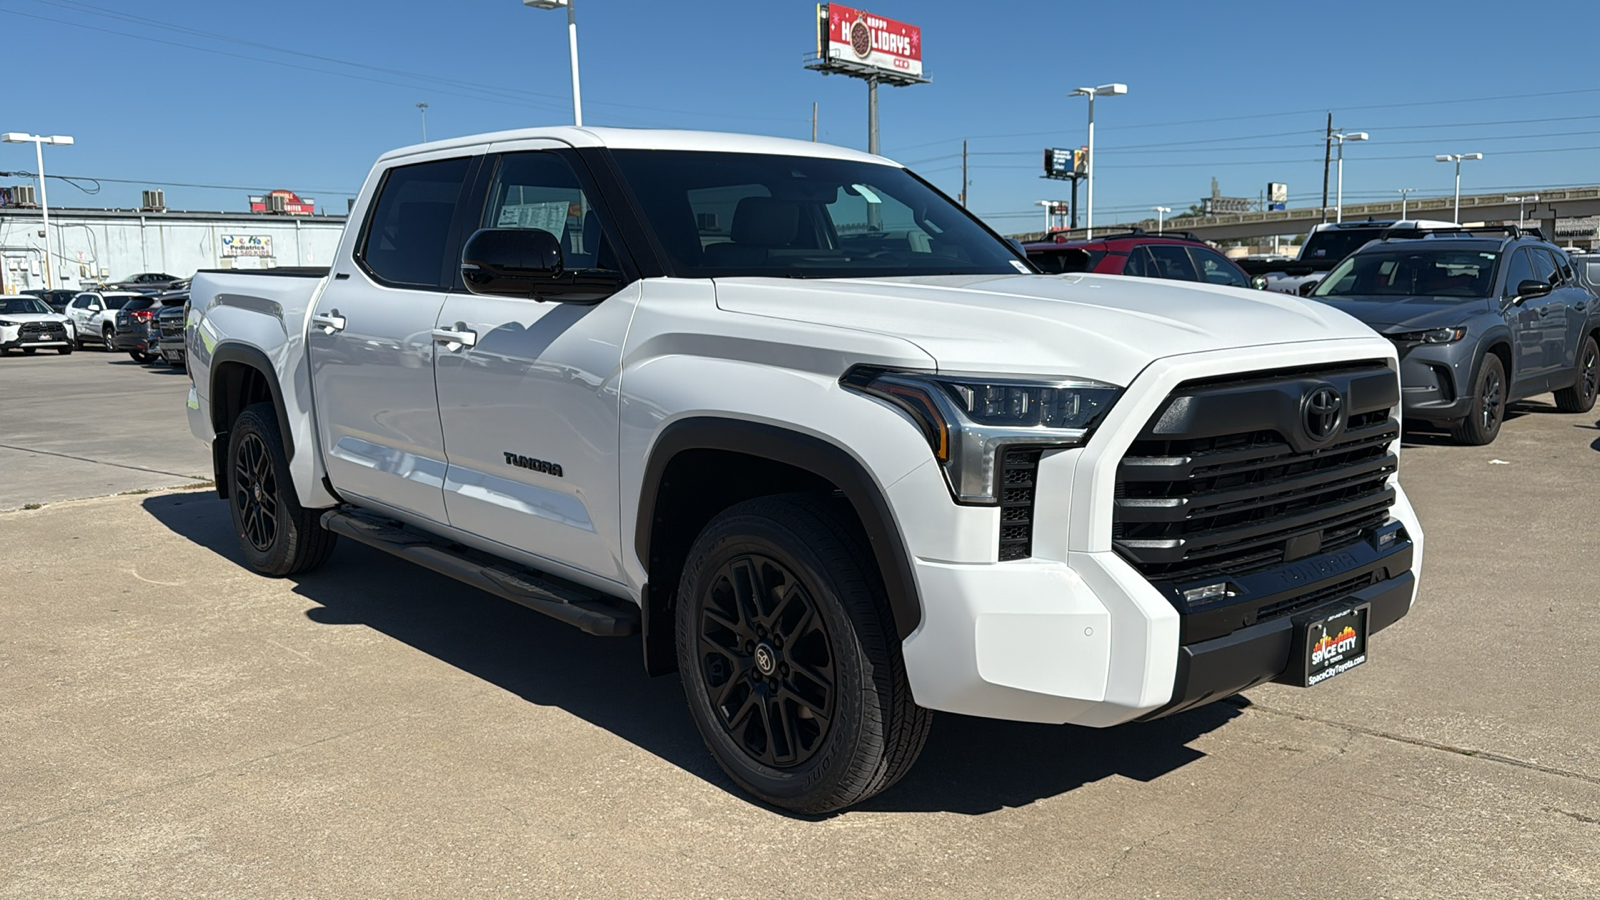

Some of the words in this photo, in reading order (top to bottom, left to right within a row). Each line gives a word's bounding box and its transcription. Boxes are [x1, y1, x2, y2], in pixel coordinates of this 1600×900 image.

[867, 16, 887, 30] HAPPY
[842, 20, 910, 56] HOLIDAYS
[1555, 229, 1595, 237] URNITURE
[503, 451, 563, 477] TUNDRA
[1272, 552, 1358, 583] TUNDRA
[1312, 643, 1337, 665] SPACE
[1337, 636, 1357, 653] CITY
[1309, 655, 1365, 685] SpaceCityToyota.com
